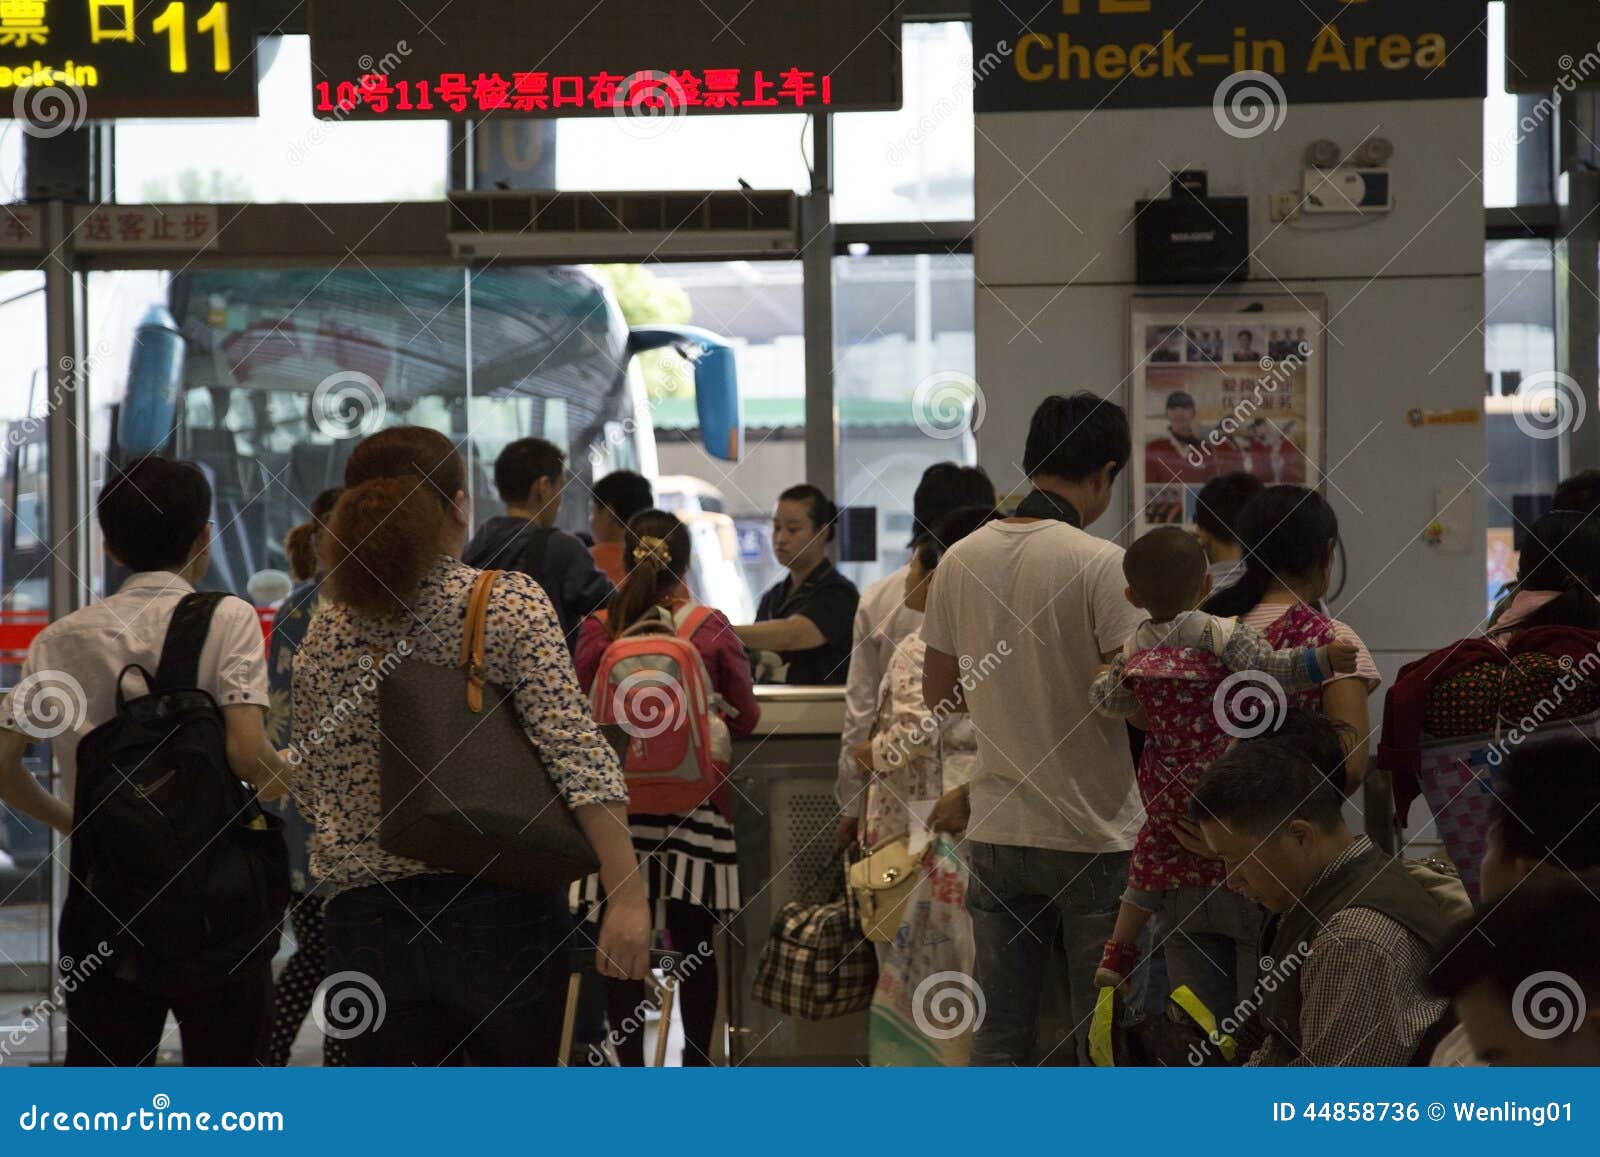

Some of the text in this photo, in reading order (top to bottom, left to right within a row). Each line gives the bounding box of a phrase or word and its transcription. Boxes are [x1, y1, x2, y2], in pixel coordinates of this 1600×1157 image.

[1014, 23, 1448, 81] Check-in Area
[85, 213, 209, 242] 送客止步
